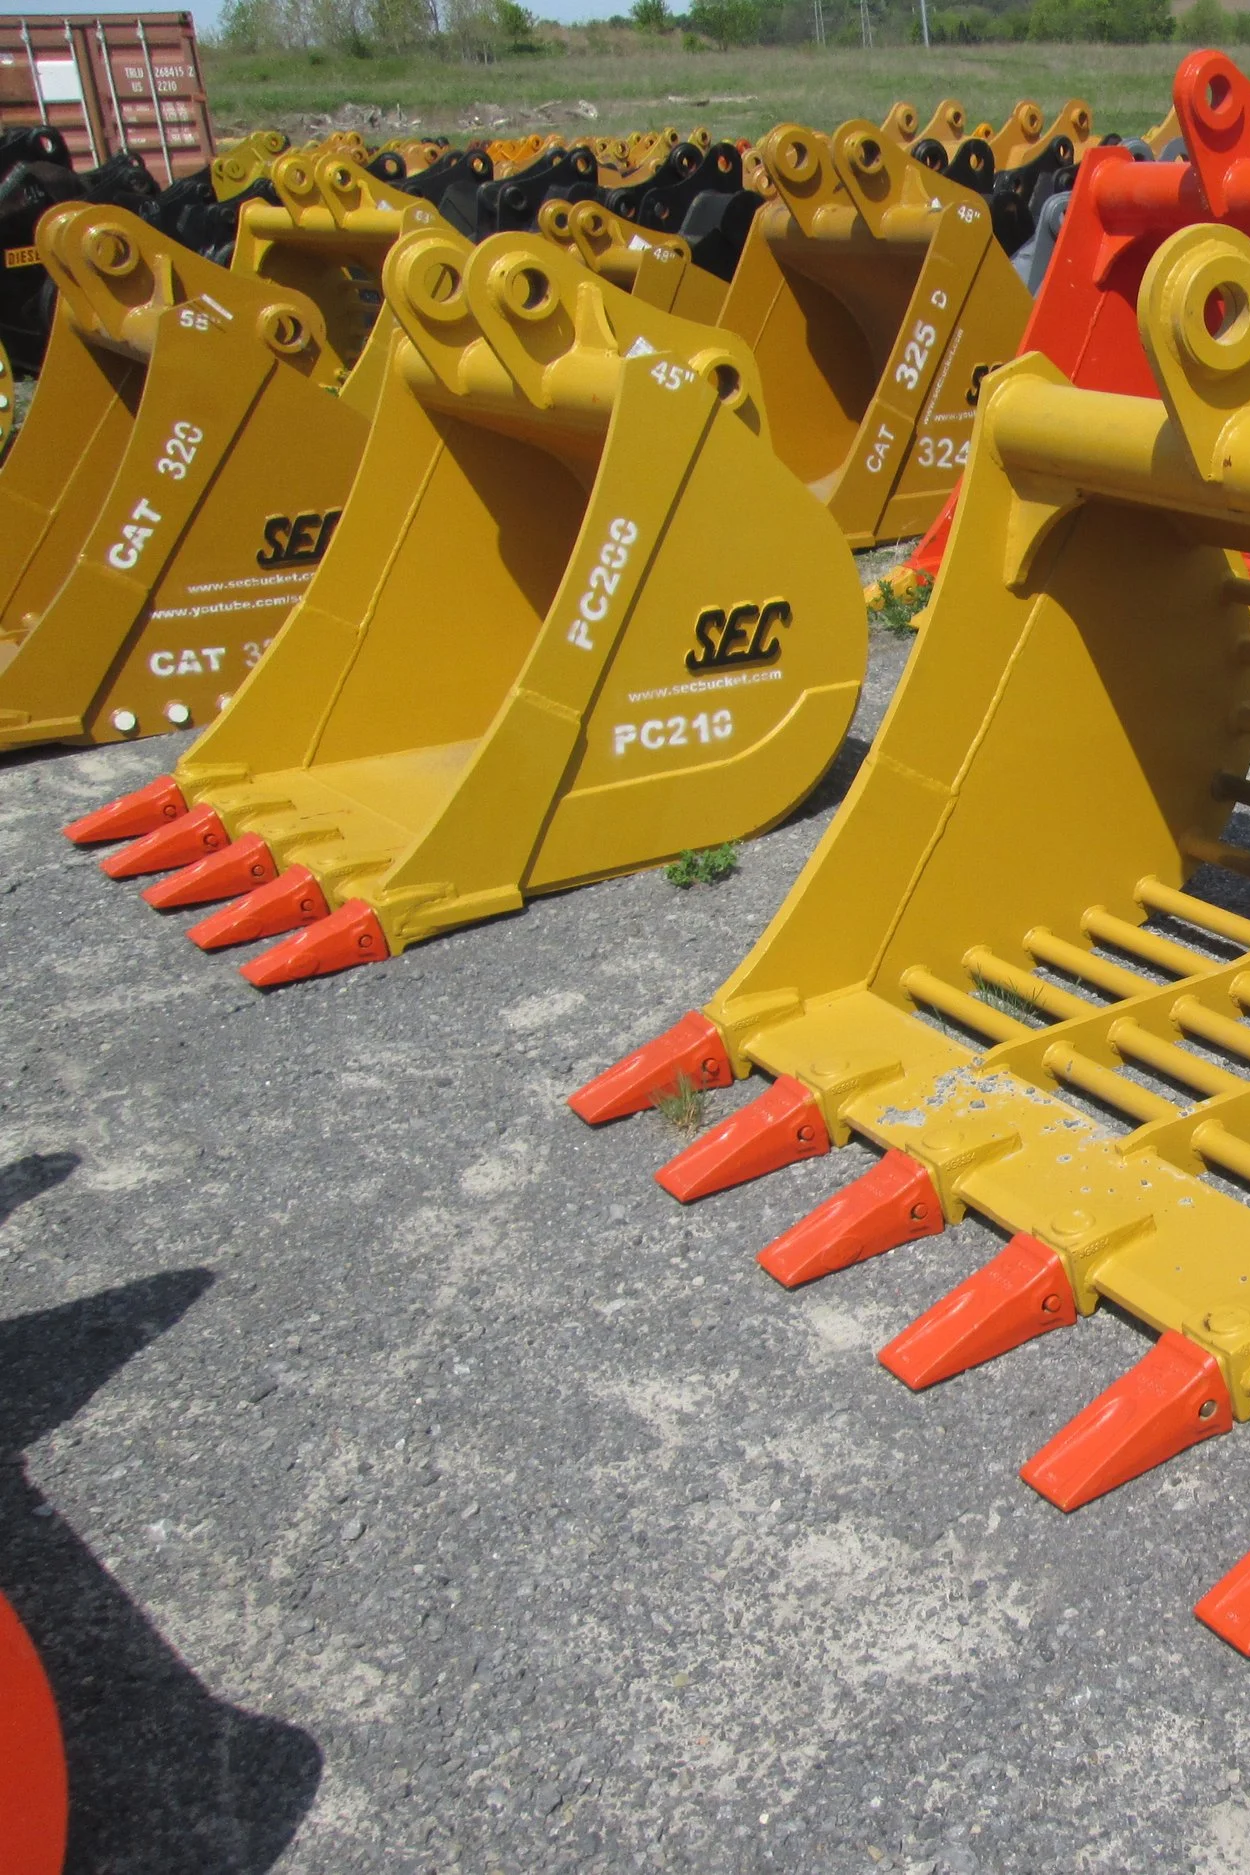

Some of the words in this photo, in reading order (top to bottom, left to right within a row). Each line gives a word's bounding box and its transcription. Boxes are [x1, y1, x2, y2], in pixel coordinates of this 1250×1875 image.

[649, 360, 696, 392] 45"
[865, 422, 897, 474] CAT
[894, 319, 938, 391] 325
[107, 497, 162, 570] CAT
[155, 420, 204, 481] 320
[565, 515, 640, 653] PC200
[148, 645, 227, 677] CAT
[683, 595, 793, 673] SEC
[627, 667, 783, 703] www.secbucket.com
[612, 707, 734, 757] PC210
